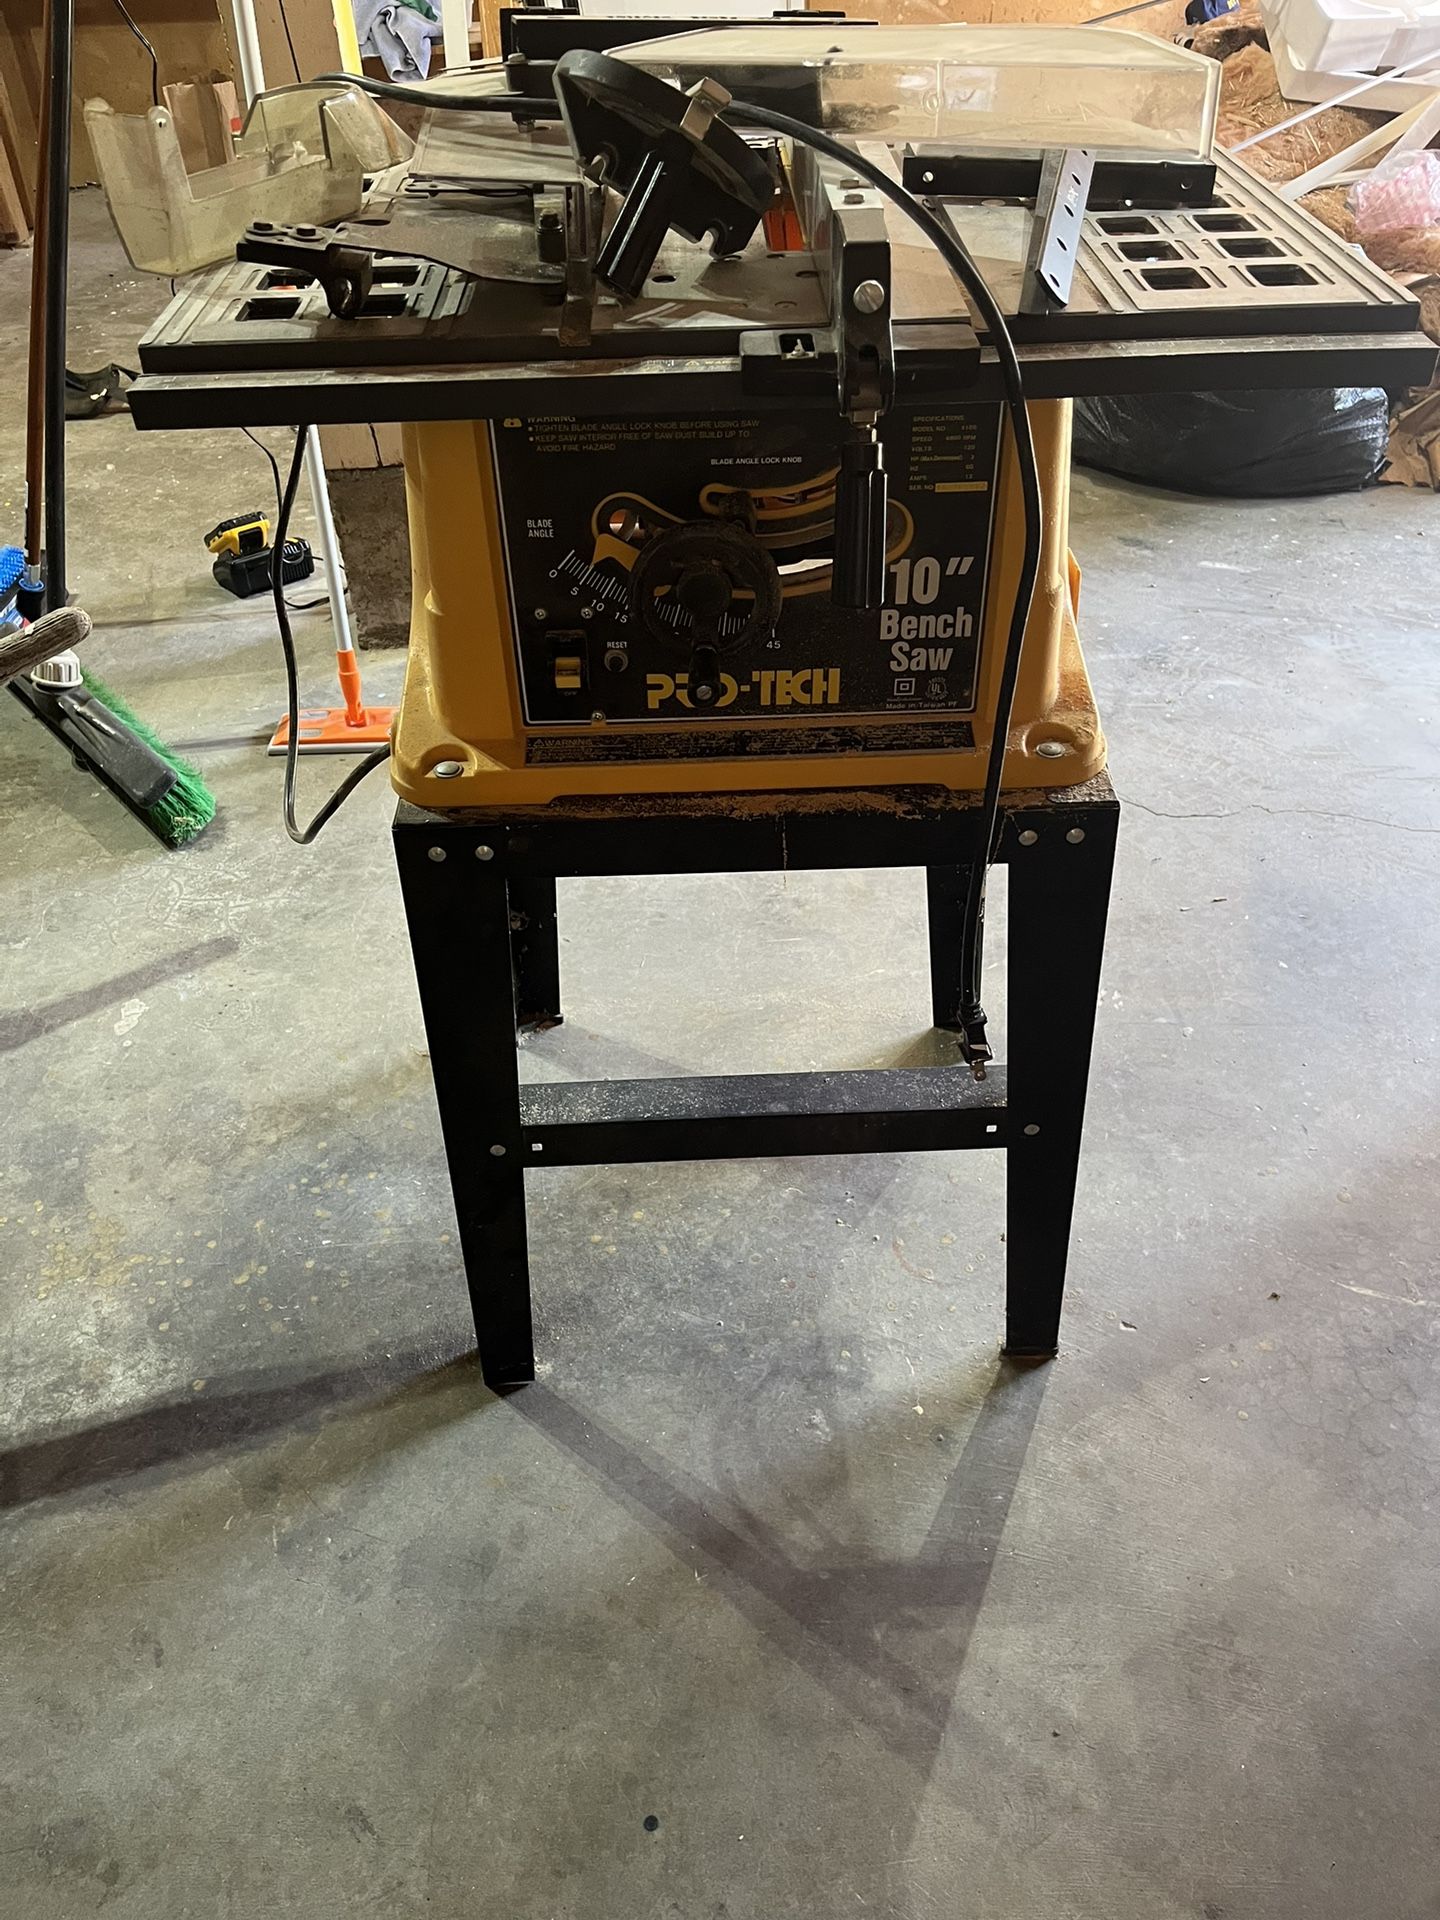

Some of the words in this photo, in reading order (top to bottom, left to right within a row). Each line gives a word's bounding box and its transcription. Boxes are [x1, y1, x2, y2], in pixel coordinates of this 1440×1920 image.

[571, 424, 598, 432] BLADE
[601, 423, 627, 431] ANGLE
[630, 422, 651, 430] LOCK
[680, 421, 712, 429] BEFORE
[714, 420, 739, 428] USING
[741, 419, 760, 427] SAW
[535, 434, 556, 442] KEEP
[558, 433, 576, 442] SAW
[579, 433, 616, 441] INTERIOR
[619, 432, 638, 440] FREE
[641, 431, 652, 440] OF
[654, 431, 673, 439] SAW
[675, 430, 696, 439] DUST
[725, 429, 736, 438] UP
[739, 429, 750, 437] TO
[536, 445, 561, 453] AVOID
[563, 444, 580, 452] FIRE
[582, 443, 617, 452] HAZARD
[735, 457, 760, 465] ANGLE
[761, 456, 781, 464] LOCK
[782, 456, 802, 464] KNOB
[527, 519, 553, 528] BLADE
[528, 529, 554, 538] ANGLE
[548, 569, 558, 579] 0
[570, 586, 579, 596] 5
[591, 599, 605, 612] 10
[614, 612, 628, 624] 15
[880, 606, 973, 640] Bench
[606, 641, 628, 649] RESET
[766, 640, 781, 649] 45
[889, 641, 953, 672] Saw
